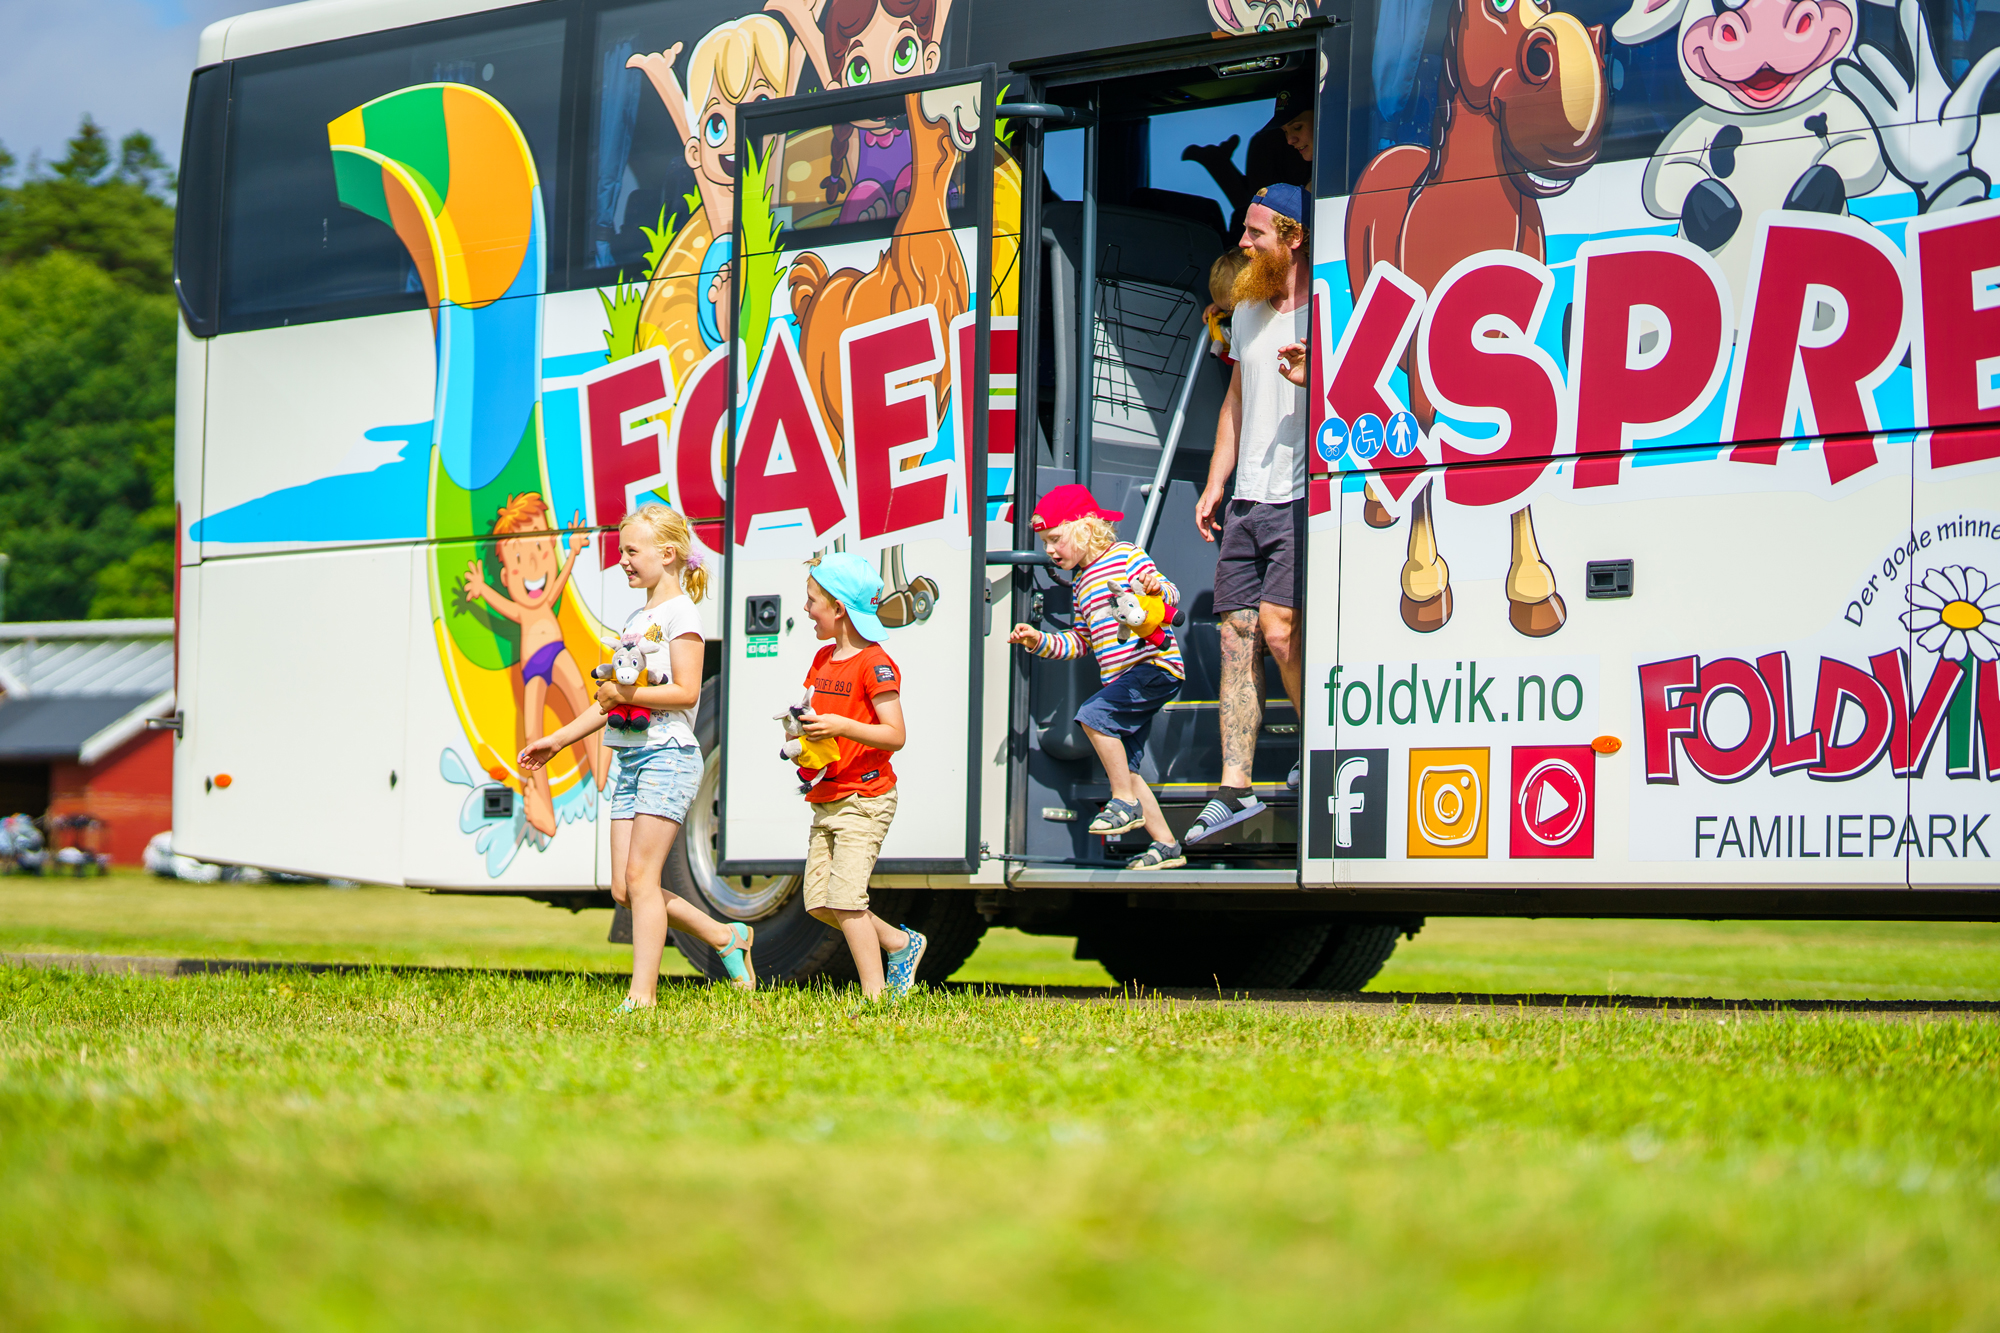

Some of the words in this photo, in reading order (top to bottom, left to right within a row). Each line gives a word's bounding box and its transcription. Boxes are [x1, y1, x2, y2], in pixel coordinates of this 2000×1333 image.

[1844, 574, 1879, 627] Der
[1883, 529, 1932, 581] gode
[1324, 661, 1584, 726] foldvik.no
[1695, 814, 1991, 858] FAMILIEPARK
